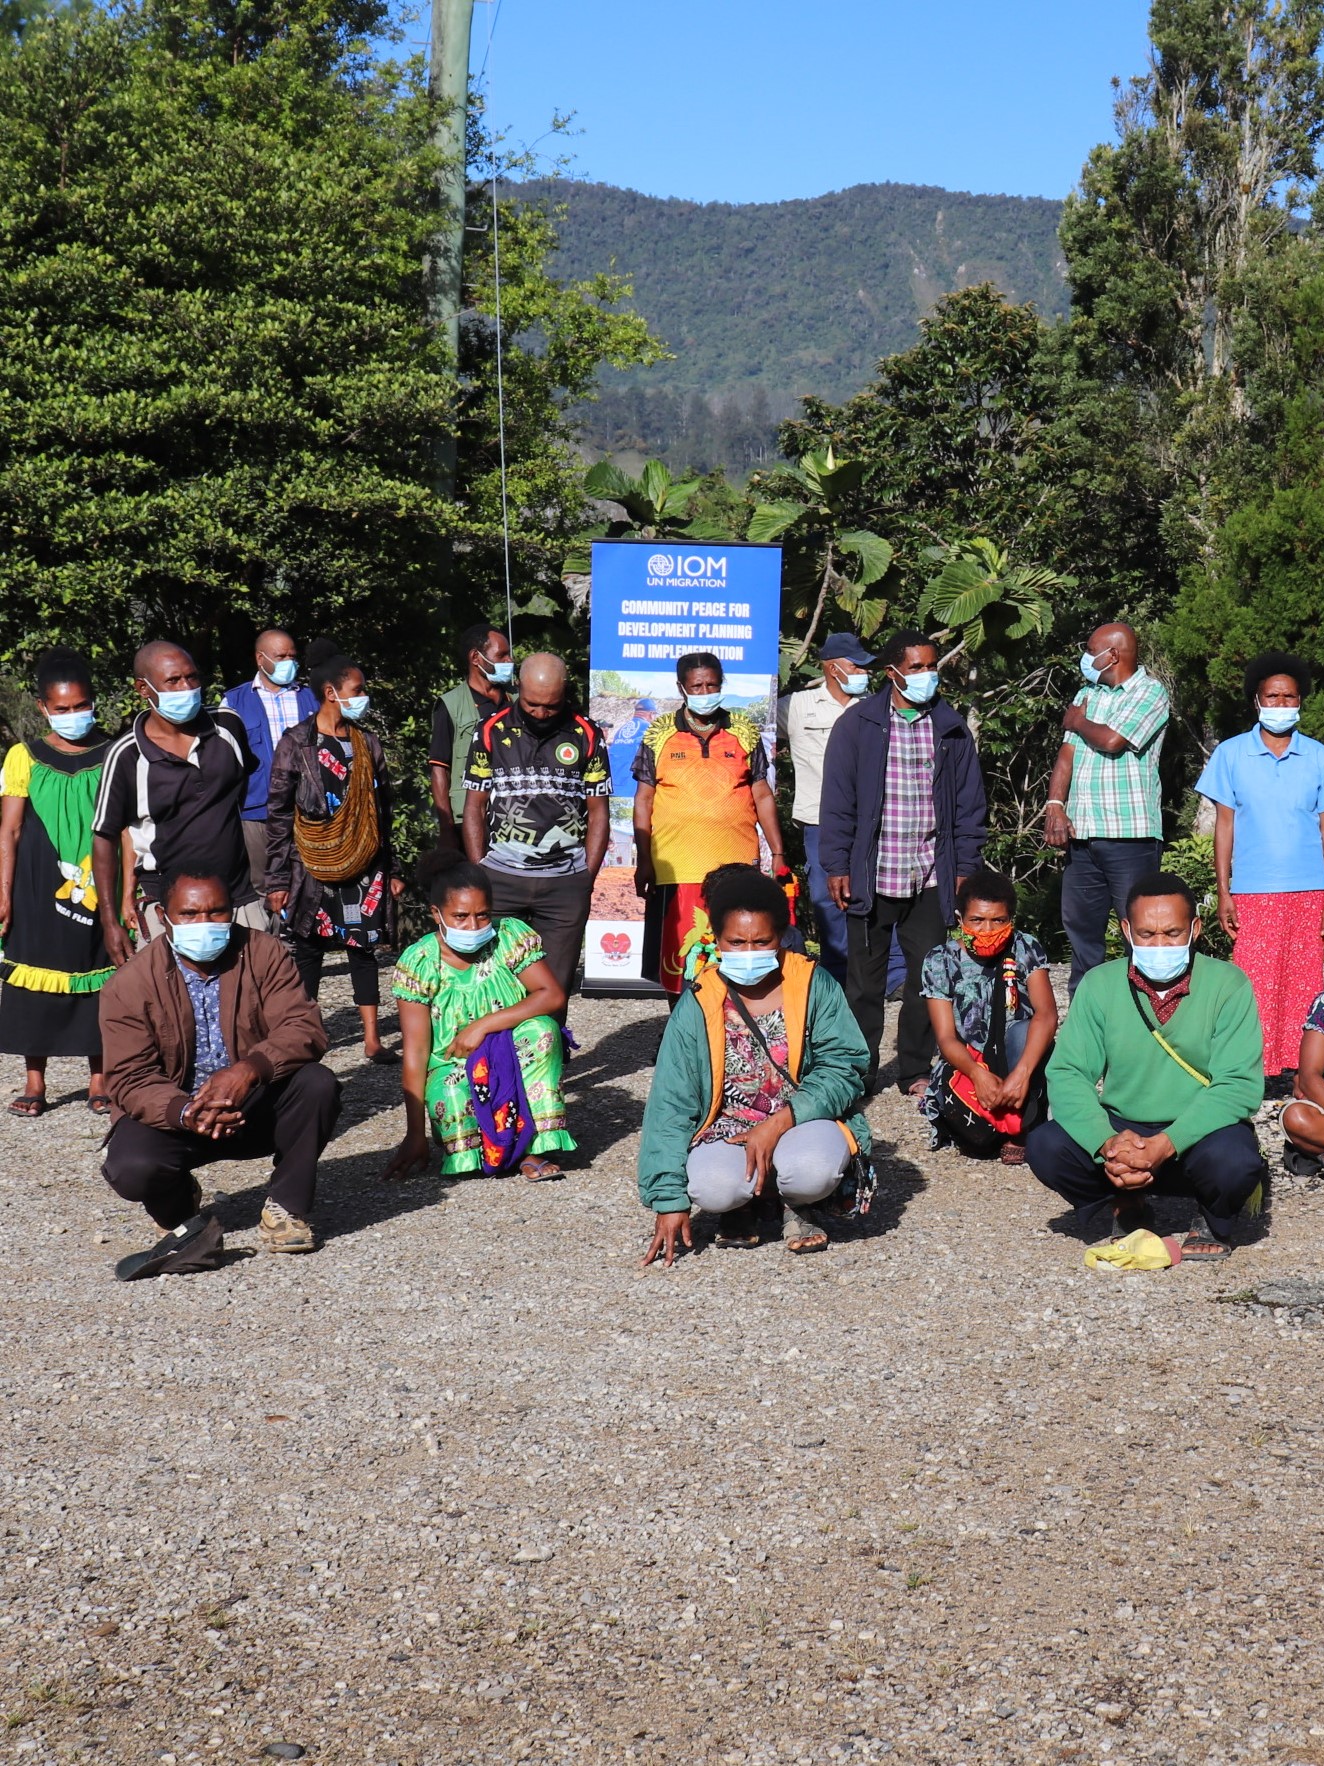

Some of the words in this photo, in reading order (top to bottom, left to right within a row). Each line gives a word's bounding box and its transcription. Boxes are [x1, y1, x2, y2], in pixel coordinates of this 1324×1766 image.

[677, 555, 727, 578] IOM
[646, 577, 664, 587] UN
[666, 578, 726, 588] MIGRATION
[621, 600, 690, 616] COMMUNITY
[691, 602, 726, 617] PEACE
[728, 603, 750, 618] FOR
[618, 621, 697, 638] DEVELOPMENT
[698, 623, 753, 640] PLANNING
[622, 643, 646, 658] AND
[71, 912, 94, 926] FLAG
